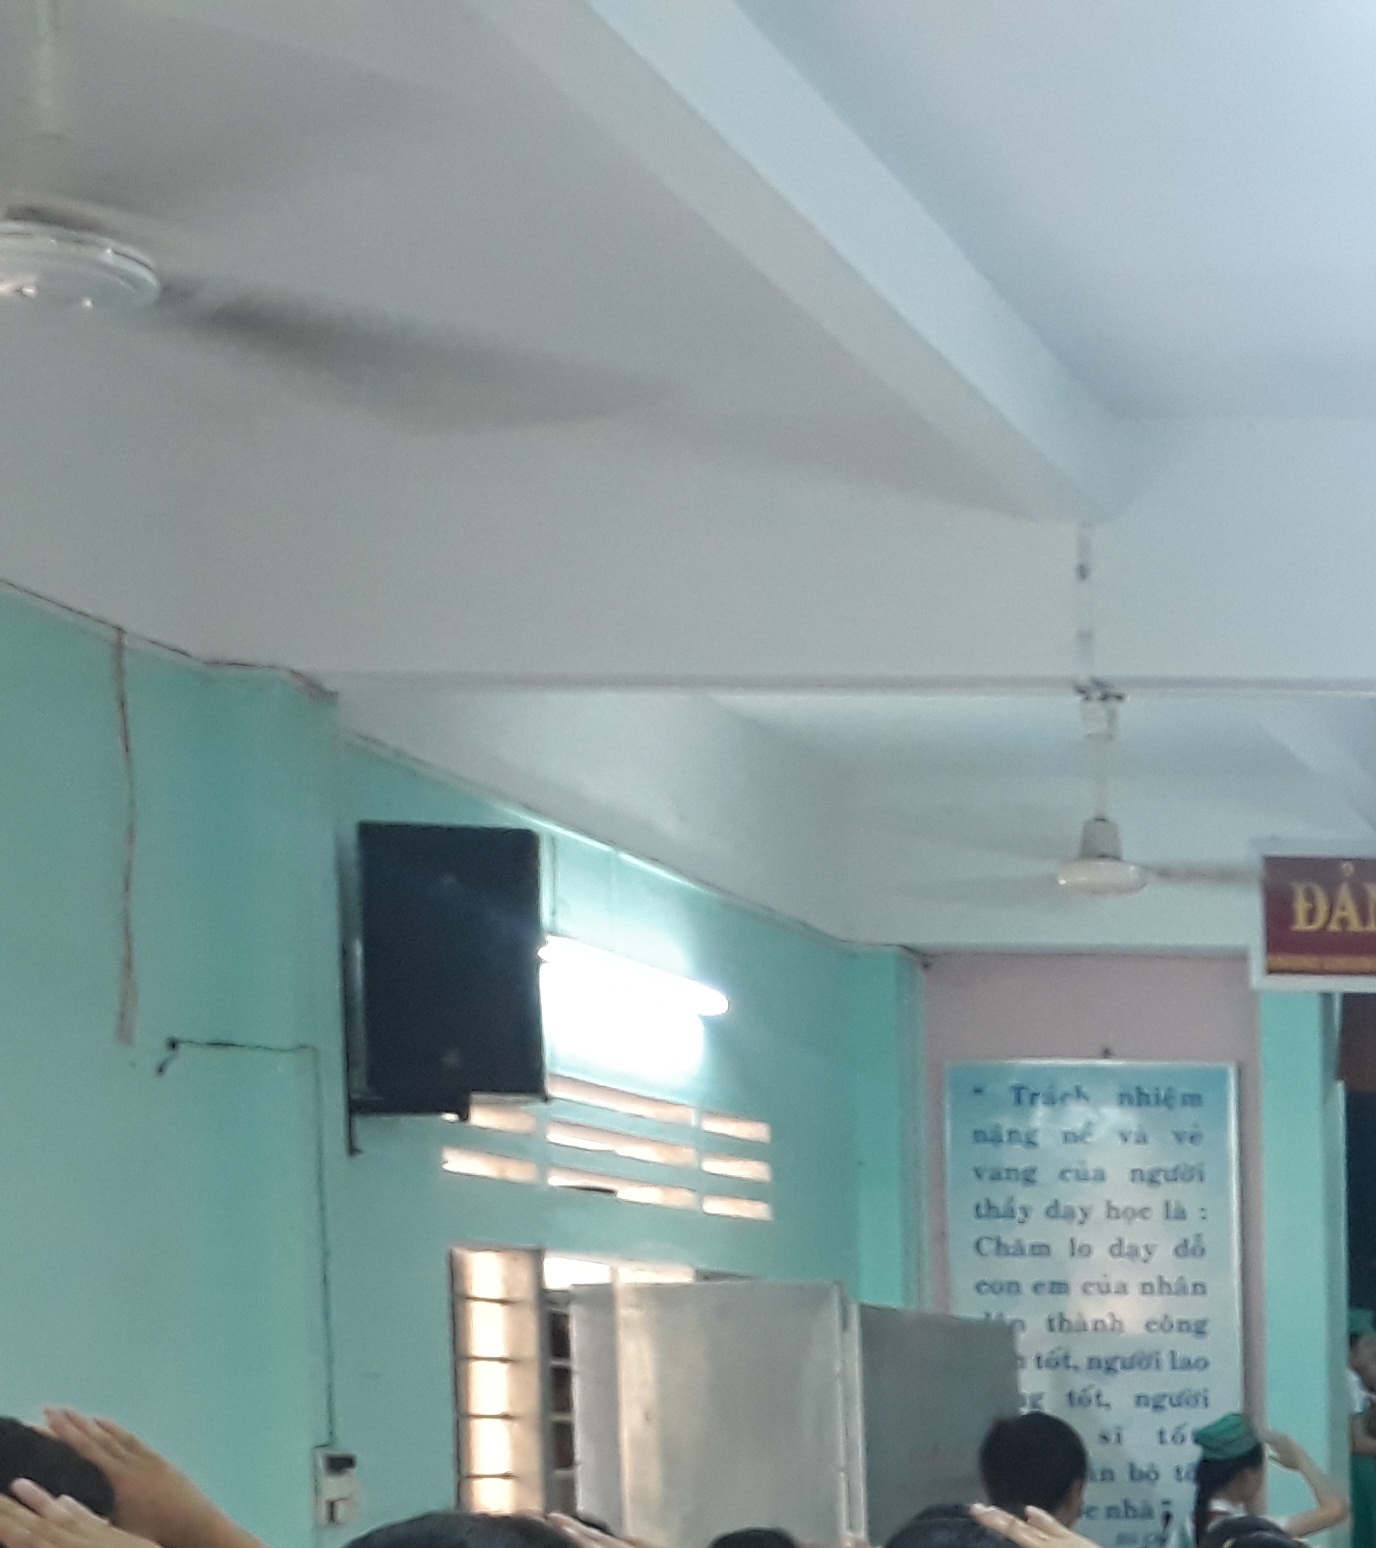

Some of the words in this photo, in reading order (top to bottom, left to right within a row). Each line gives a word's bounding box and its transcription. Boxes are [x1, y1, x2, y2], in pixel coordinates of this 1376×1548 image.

[972, 1165, 1038, 1187] vang
[1069, 1237, 1092, 1259] lo
[974, 1279, 1022, 1297] con
[1032, 1279, 1072, 1297] em
[1169, 1349, 1211, 1371] lao
